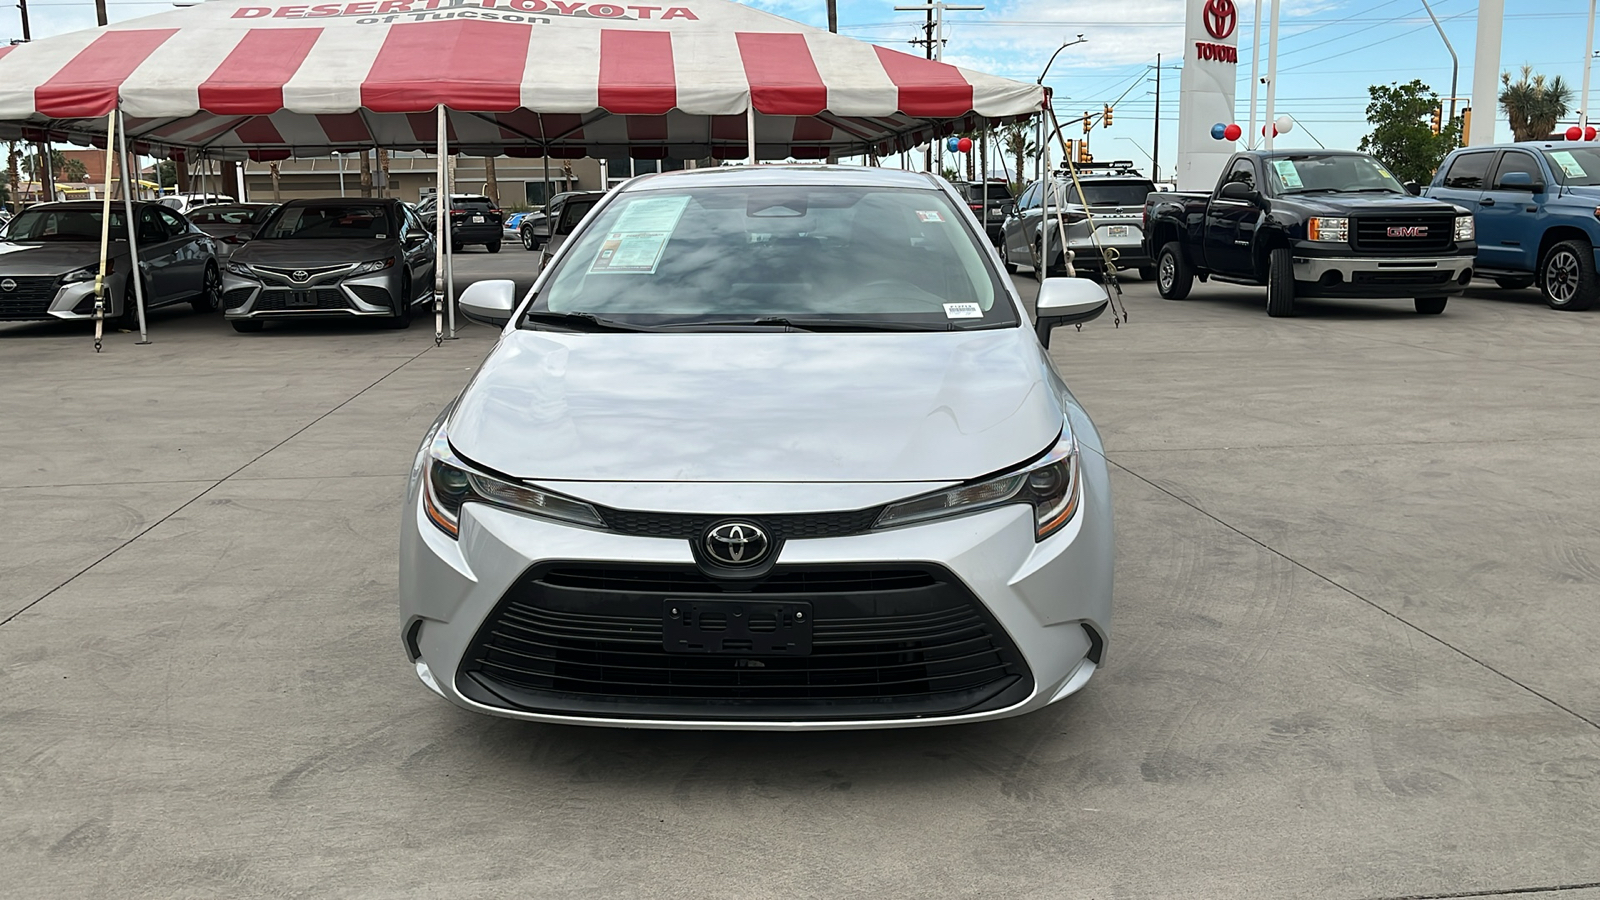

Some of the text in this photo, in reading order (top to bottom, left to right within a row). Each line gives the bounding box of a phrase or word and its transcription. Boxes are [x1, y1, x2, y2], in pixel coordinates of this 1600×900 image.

[230, 0, 700, 20] DESERT TOYOTA
[356, 11, 551, 24] of Tucson
[1195, 42, 1238, 64] TOYOTA
[1387, 226, 1429, 237] GMC
